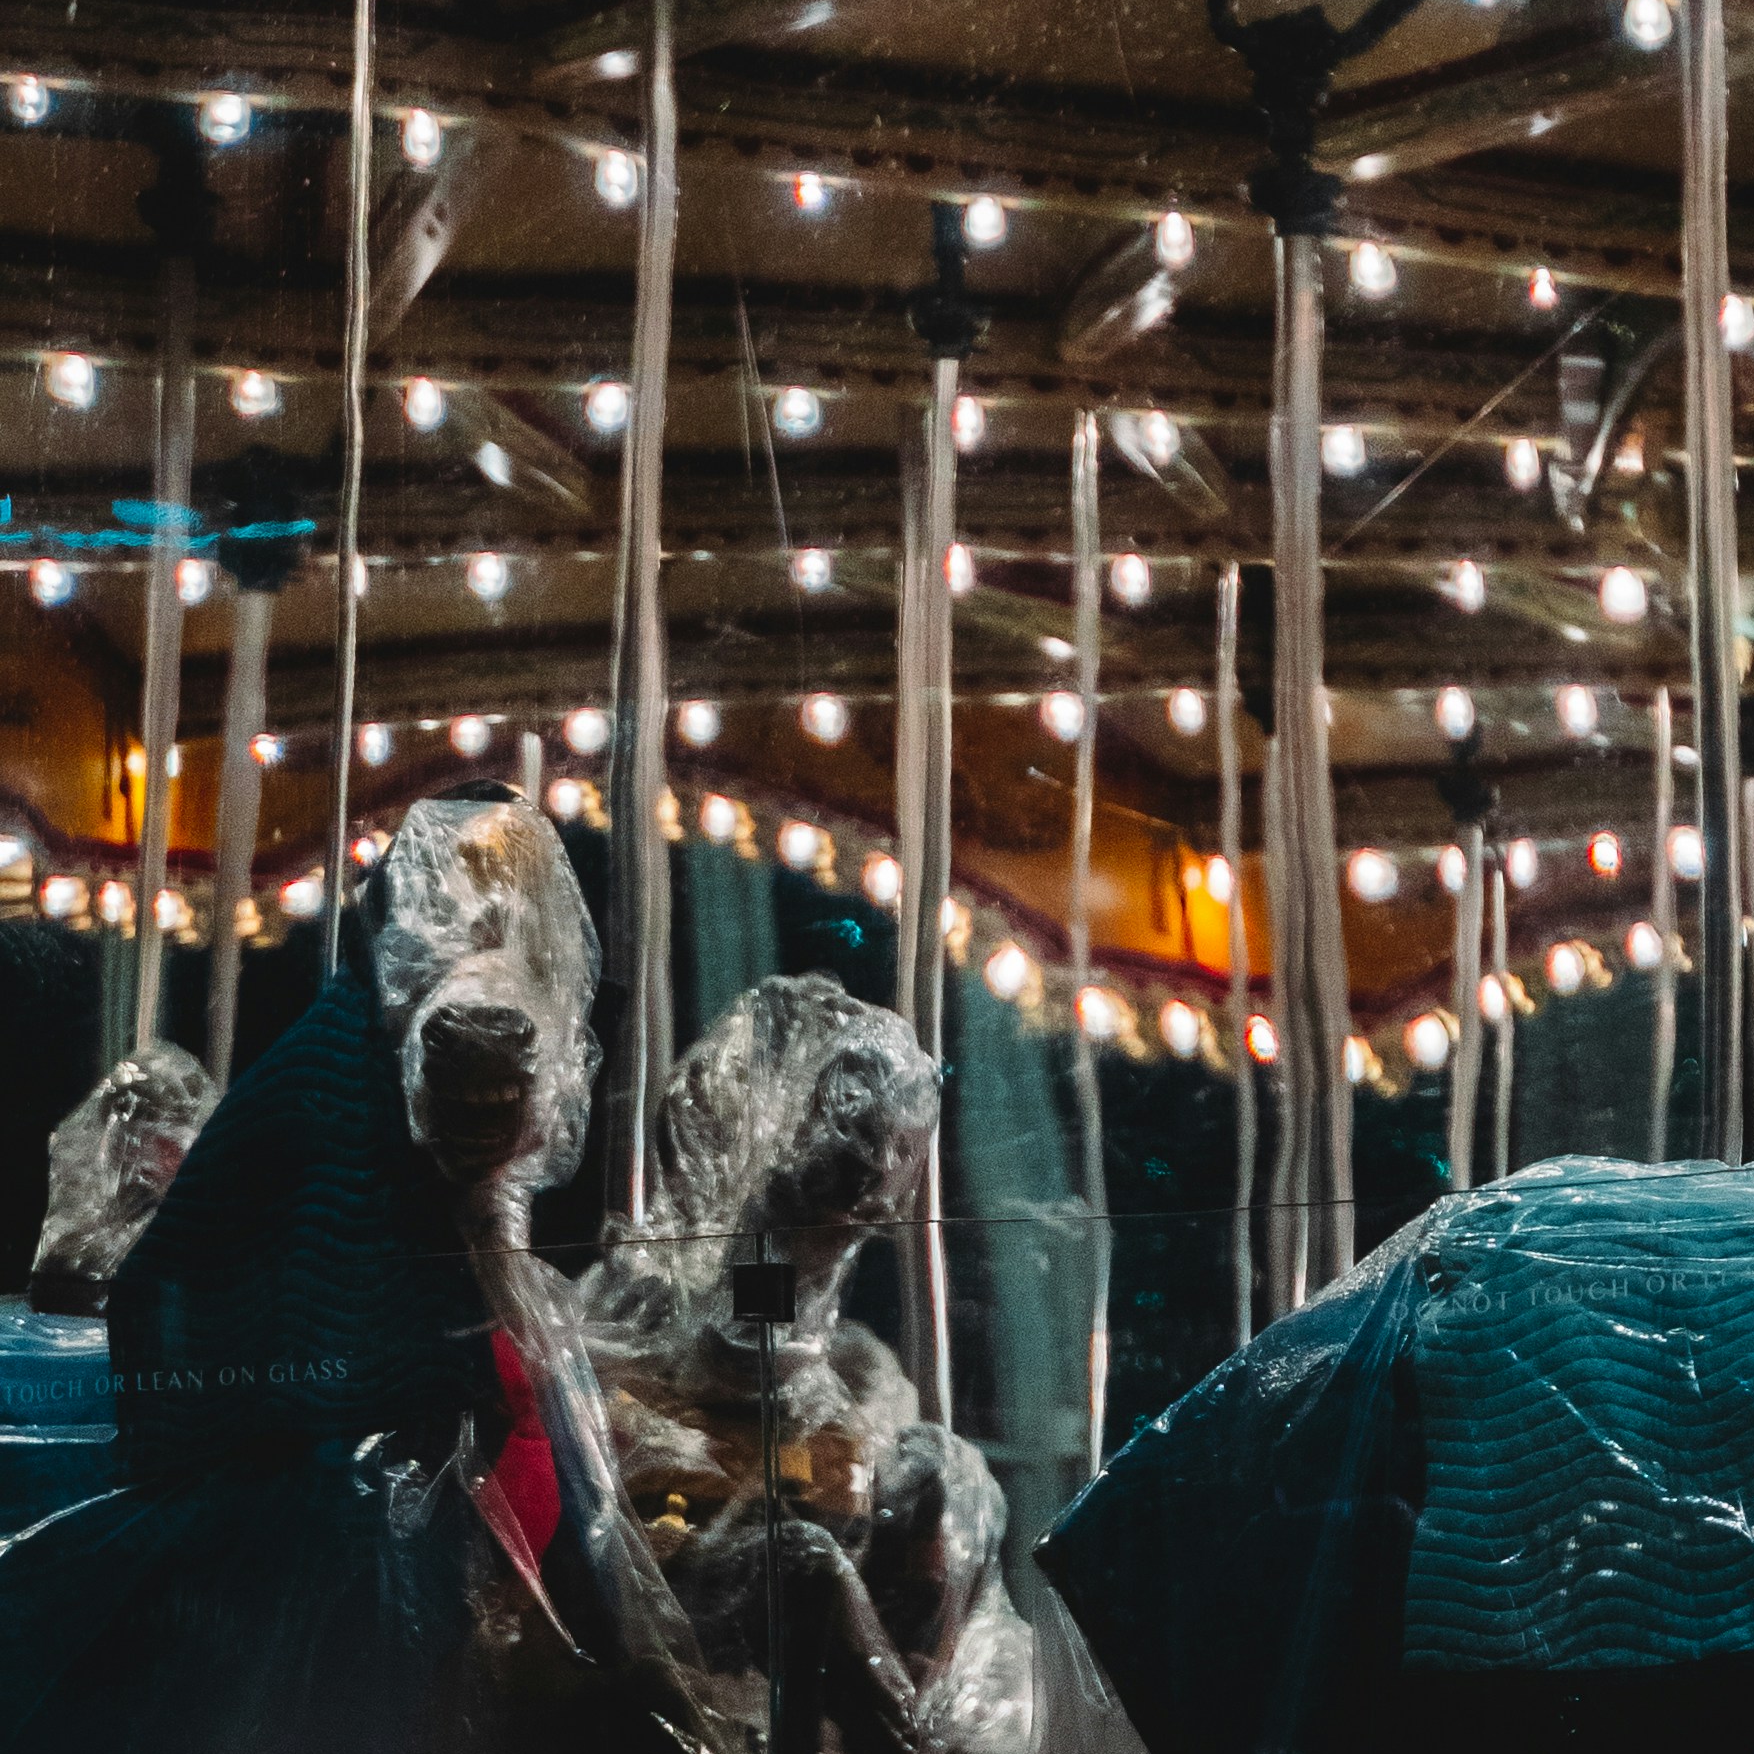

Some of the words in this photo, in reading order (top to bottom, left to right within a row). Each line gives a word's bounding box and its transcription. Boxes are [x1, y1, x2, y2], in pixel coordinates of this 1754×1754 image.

[1451, 1290, 1512, 1317] NOT
[1528, 1277, 1629, 1306] TOUCH
[1645, 1272, 1688, 1293] OR
[2, 1376, 83, 1405] TOUCH
[95, 1374, 125, 1395] OR
[137, 1369, 203, 1392] LEAN
[219, 1365, 256, 1386] ON
[269, 1358, 348, 1383] GLASS
